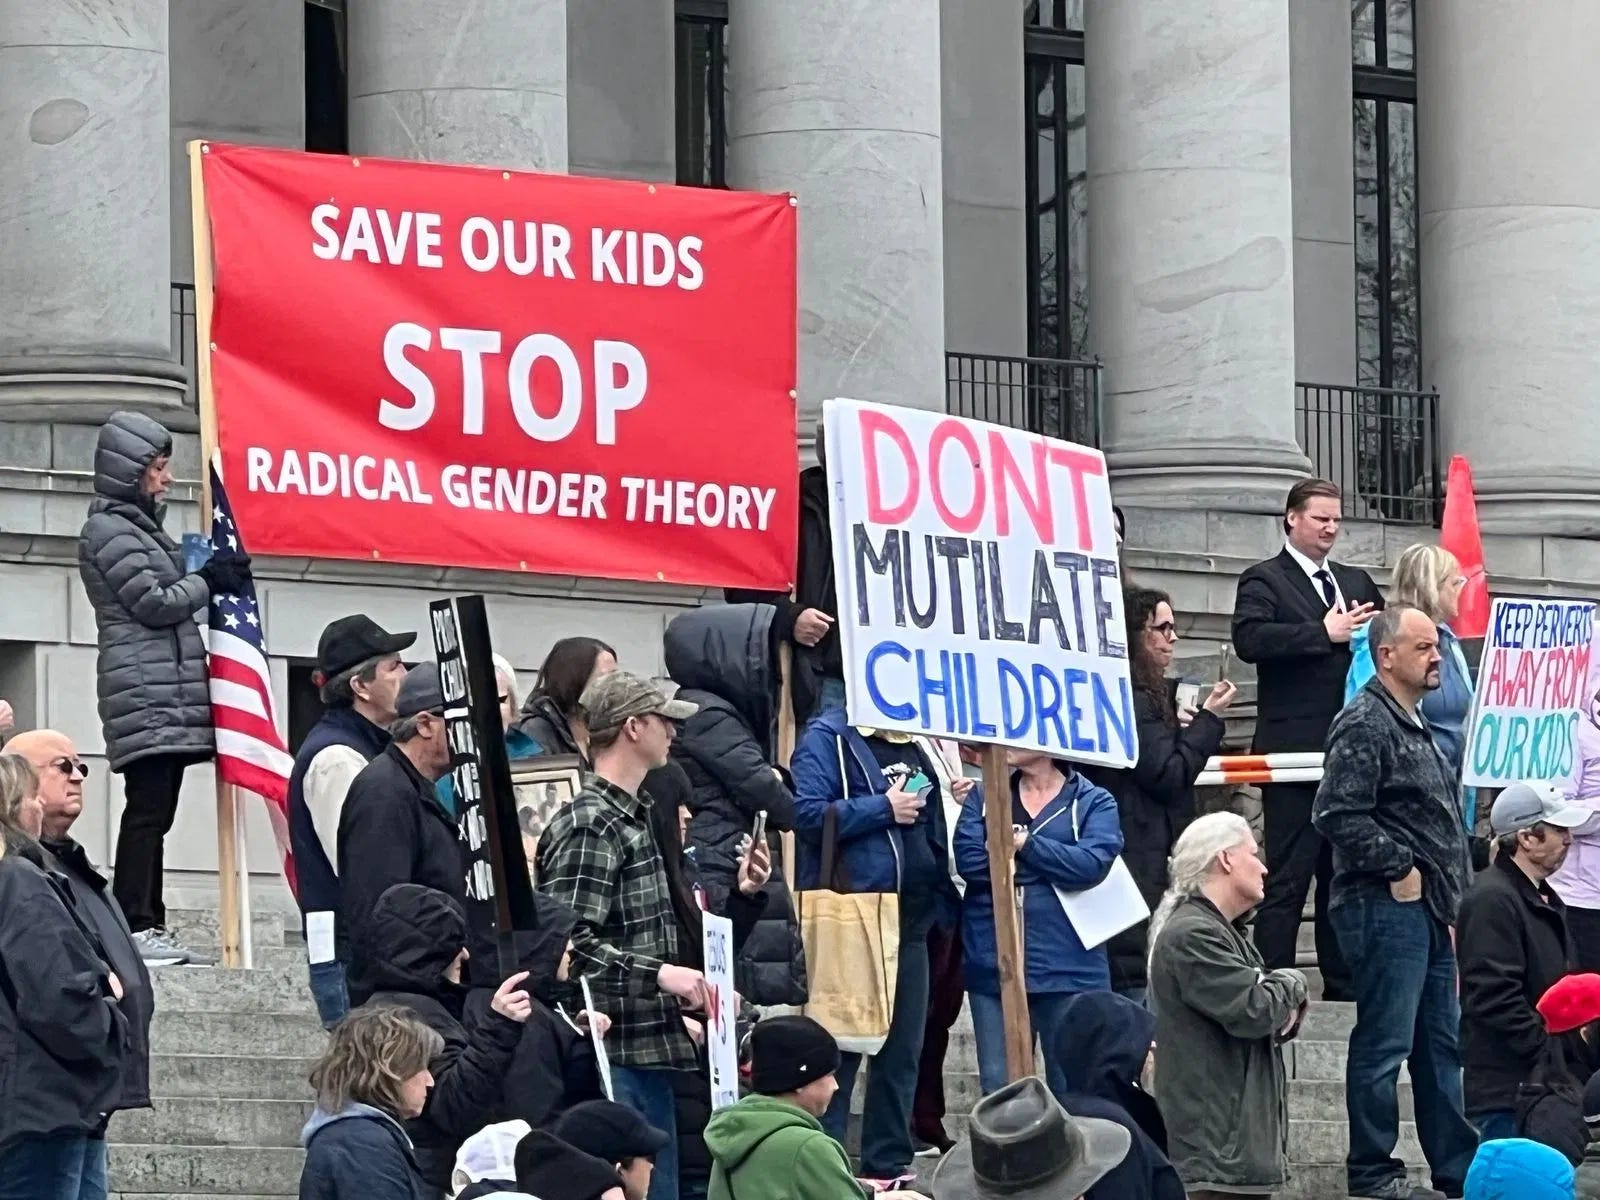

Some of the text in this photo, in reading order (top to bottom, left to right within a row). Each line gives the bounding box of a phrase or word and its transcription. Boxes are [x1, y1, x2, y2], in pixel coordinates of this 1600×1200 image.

[311, 205, 703, 291] SAVE OUR KIDS
[378, 322, 648, 445] STOP
[247, 447, 776, 531] RADICAL GENDER THEORY
[858, 409, 1103, 551] DONT
[853, 521, 1127, 659] MUTILATE
[1493, 602, 1596, 648] KEEP PERVERTS
[865, 641, 1138, 760] CHILDREN
[1484, 645, 1591, 710] AWAY FROM
[1474, 712, 1579, 779] OUR KIDS
